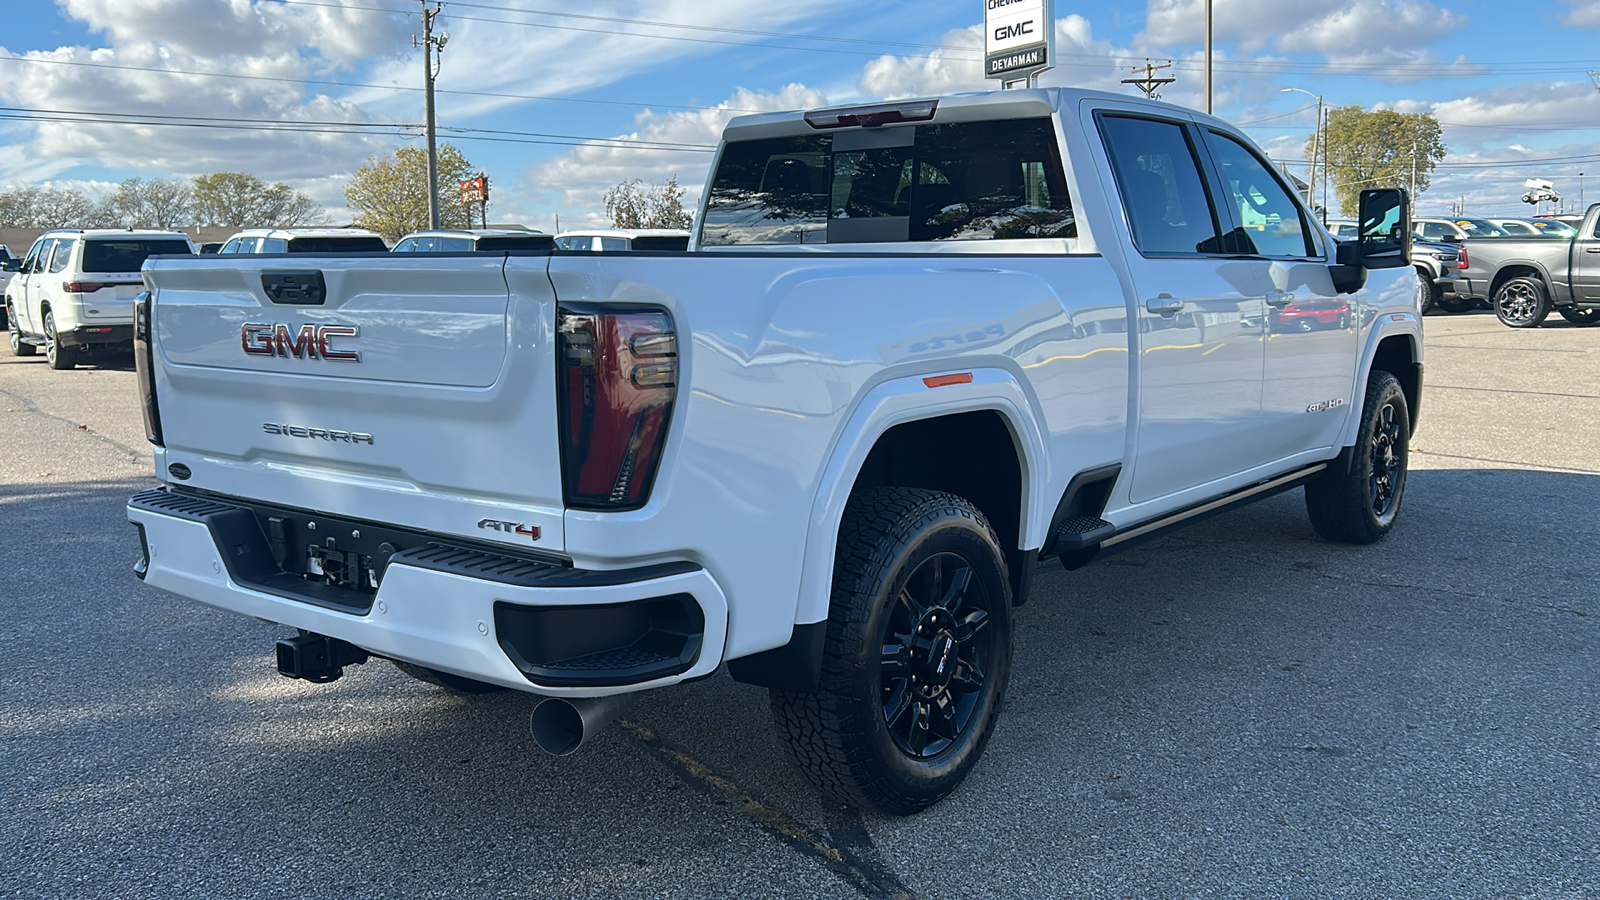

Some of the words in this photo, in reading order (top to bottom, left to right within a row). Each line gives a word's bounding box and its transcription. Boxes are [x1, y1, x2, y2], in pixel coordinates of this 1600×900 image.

[995, 20, 1033, 41] GMC
[992, 51, 1038, 71] DEYARMAN
[241, 321, 363, 363] GMC
[262, 421, 374, 445] SIERRA
[477, 517, 541, 541] AT4
